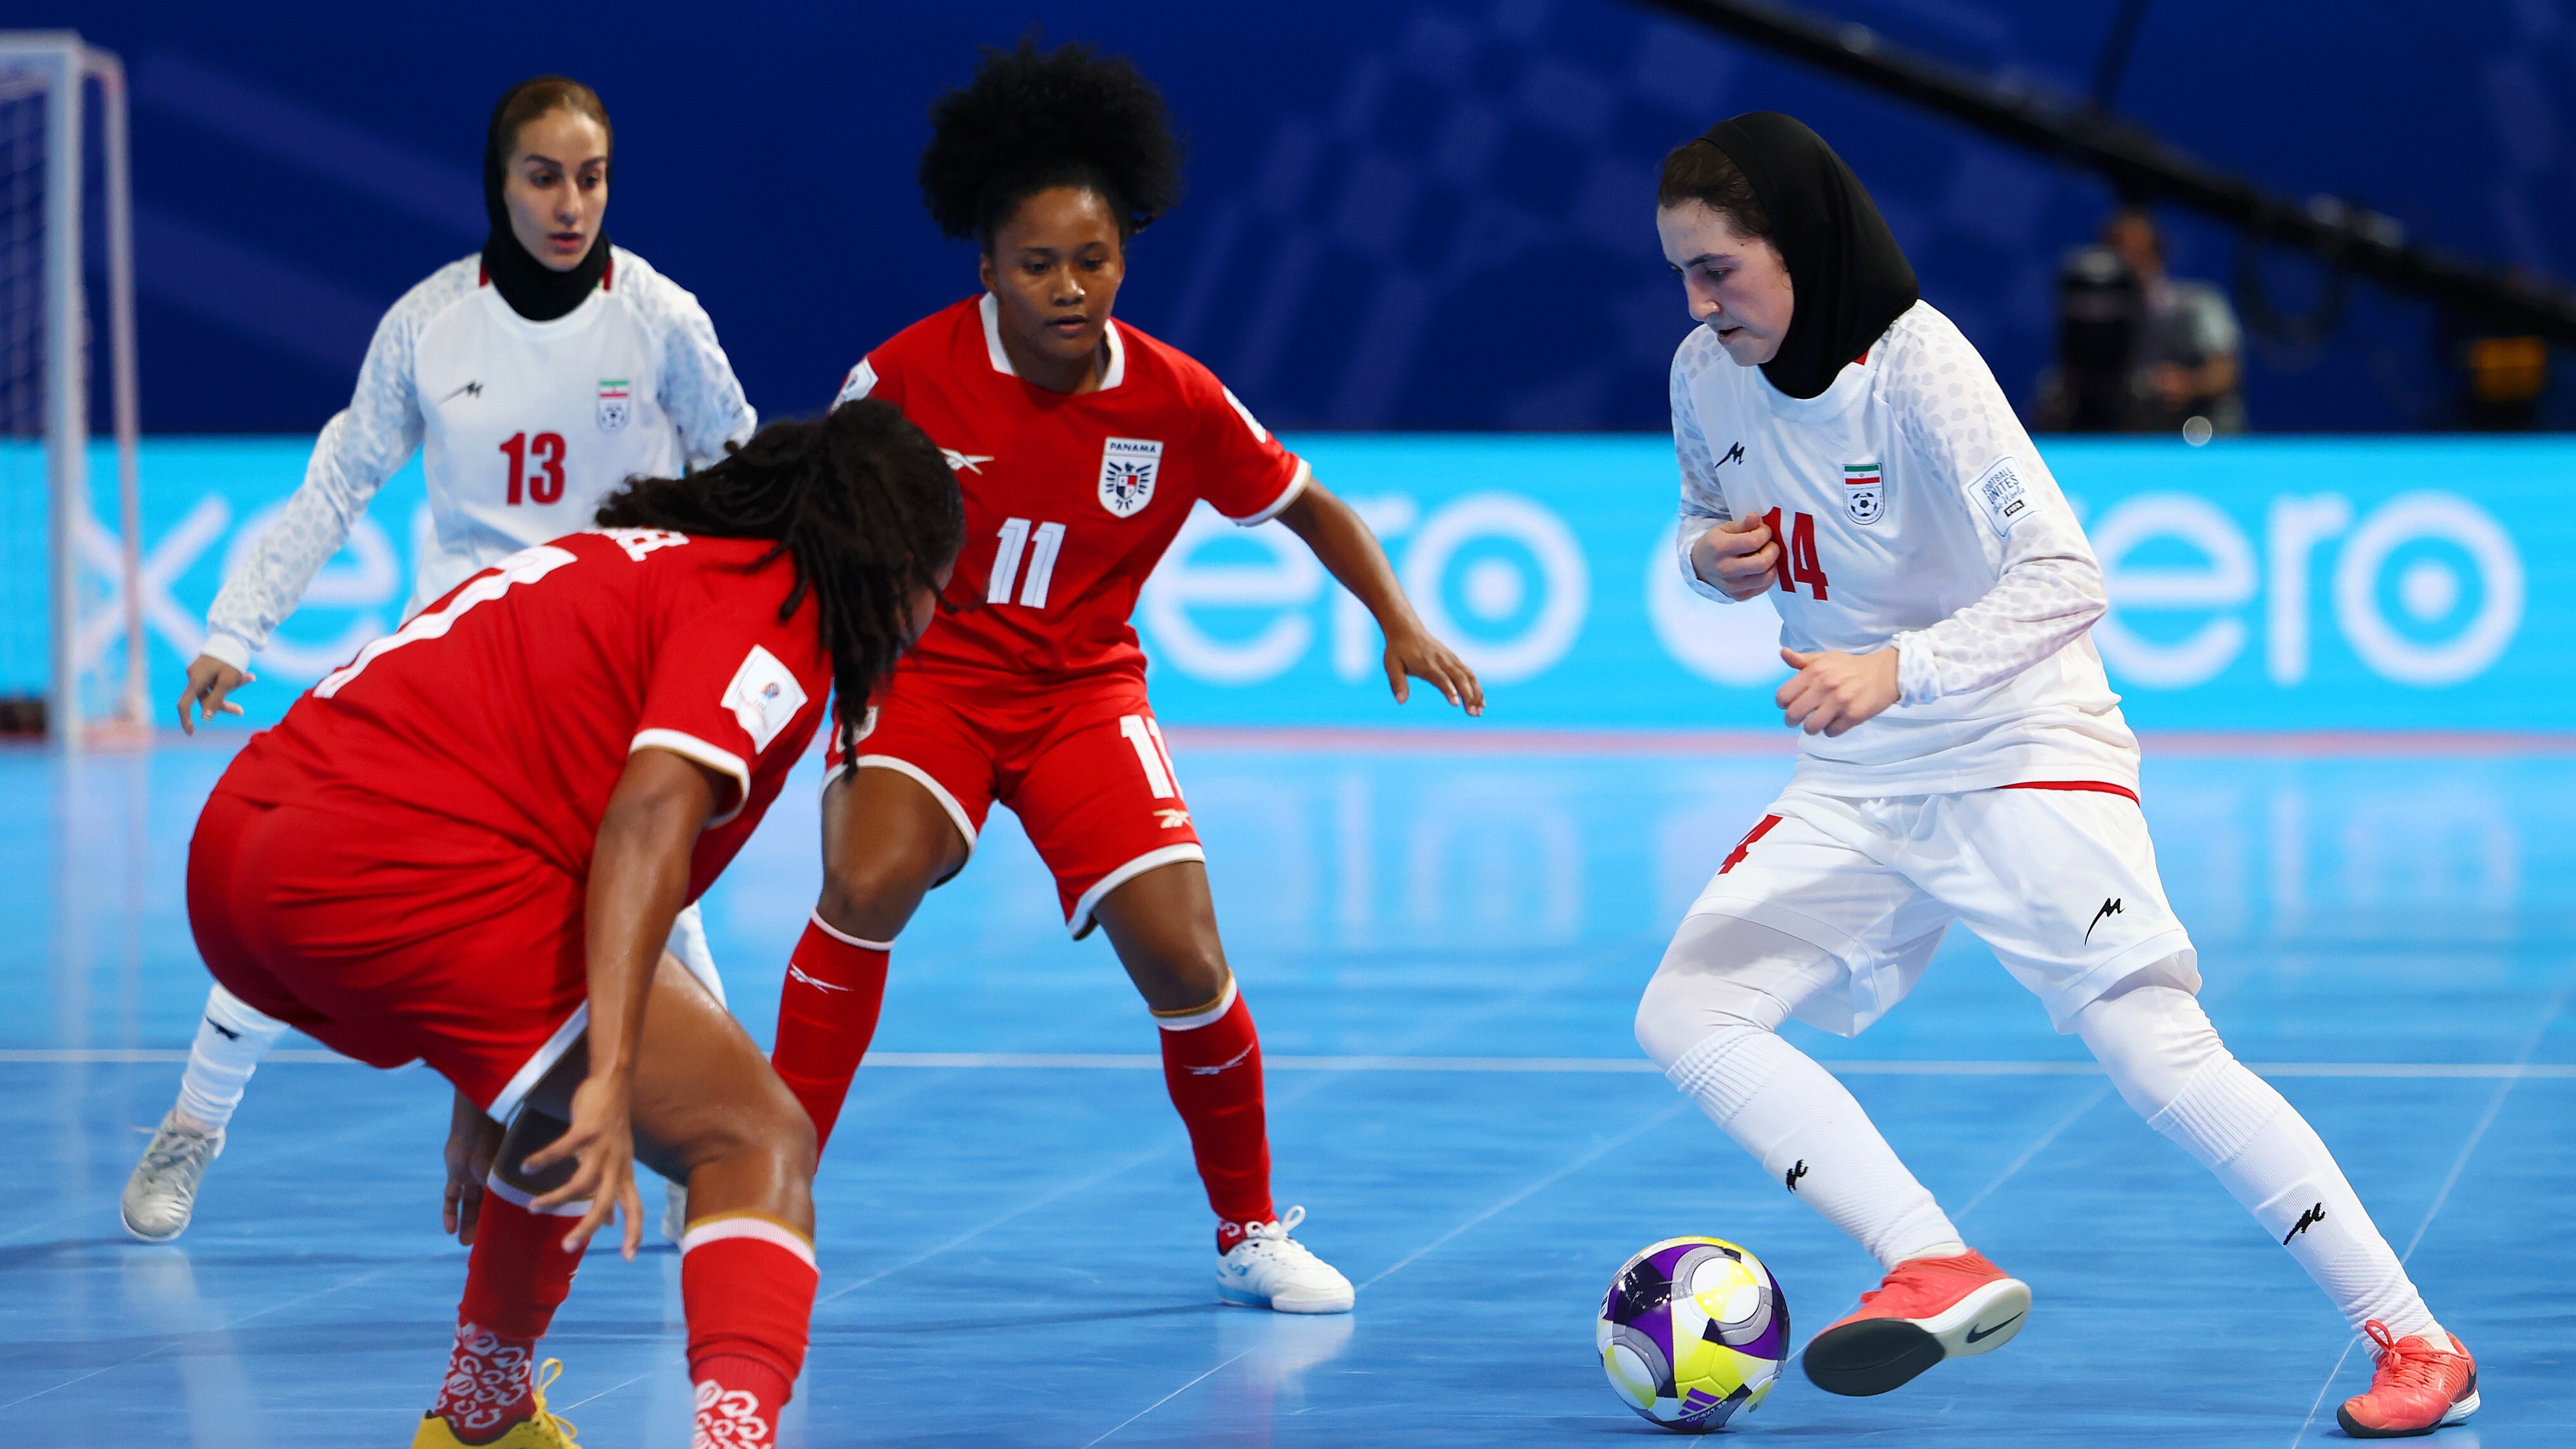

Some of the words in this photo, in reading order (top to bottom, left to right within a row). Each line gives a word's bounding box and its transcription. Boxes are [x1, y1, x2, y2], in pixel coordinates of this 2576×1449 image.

[499, 432, 566, 505] 13
[1982, 467, 2012, 495] FOOTBALL
[1988, 474, 2019, 504] UNITES
[987, 517, 1067, 609] 11
[1139, 491, 1590, 687] ero
[1761, 507, 1829, 601] 14
[2073, 488, 2526, 690] ero
